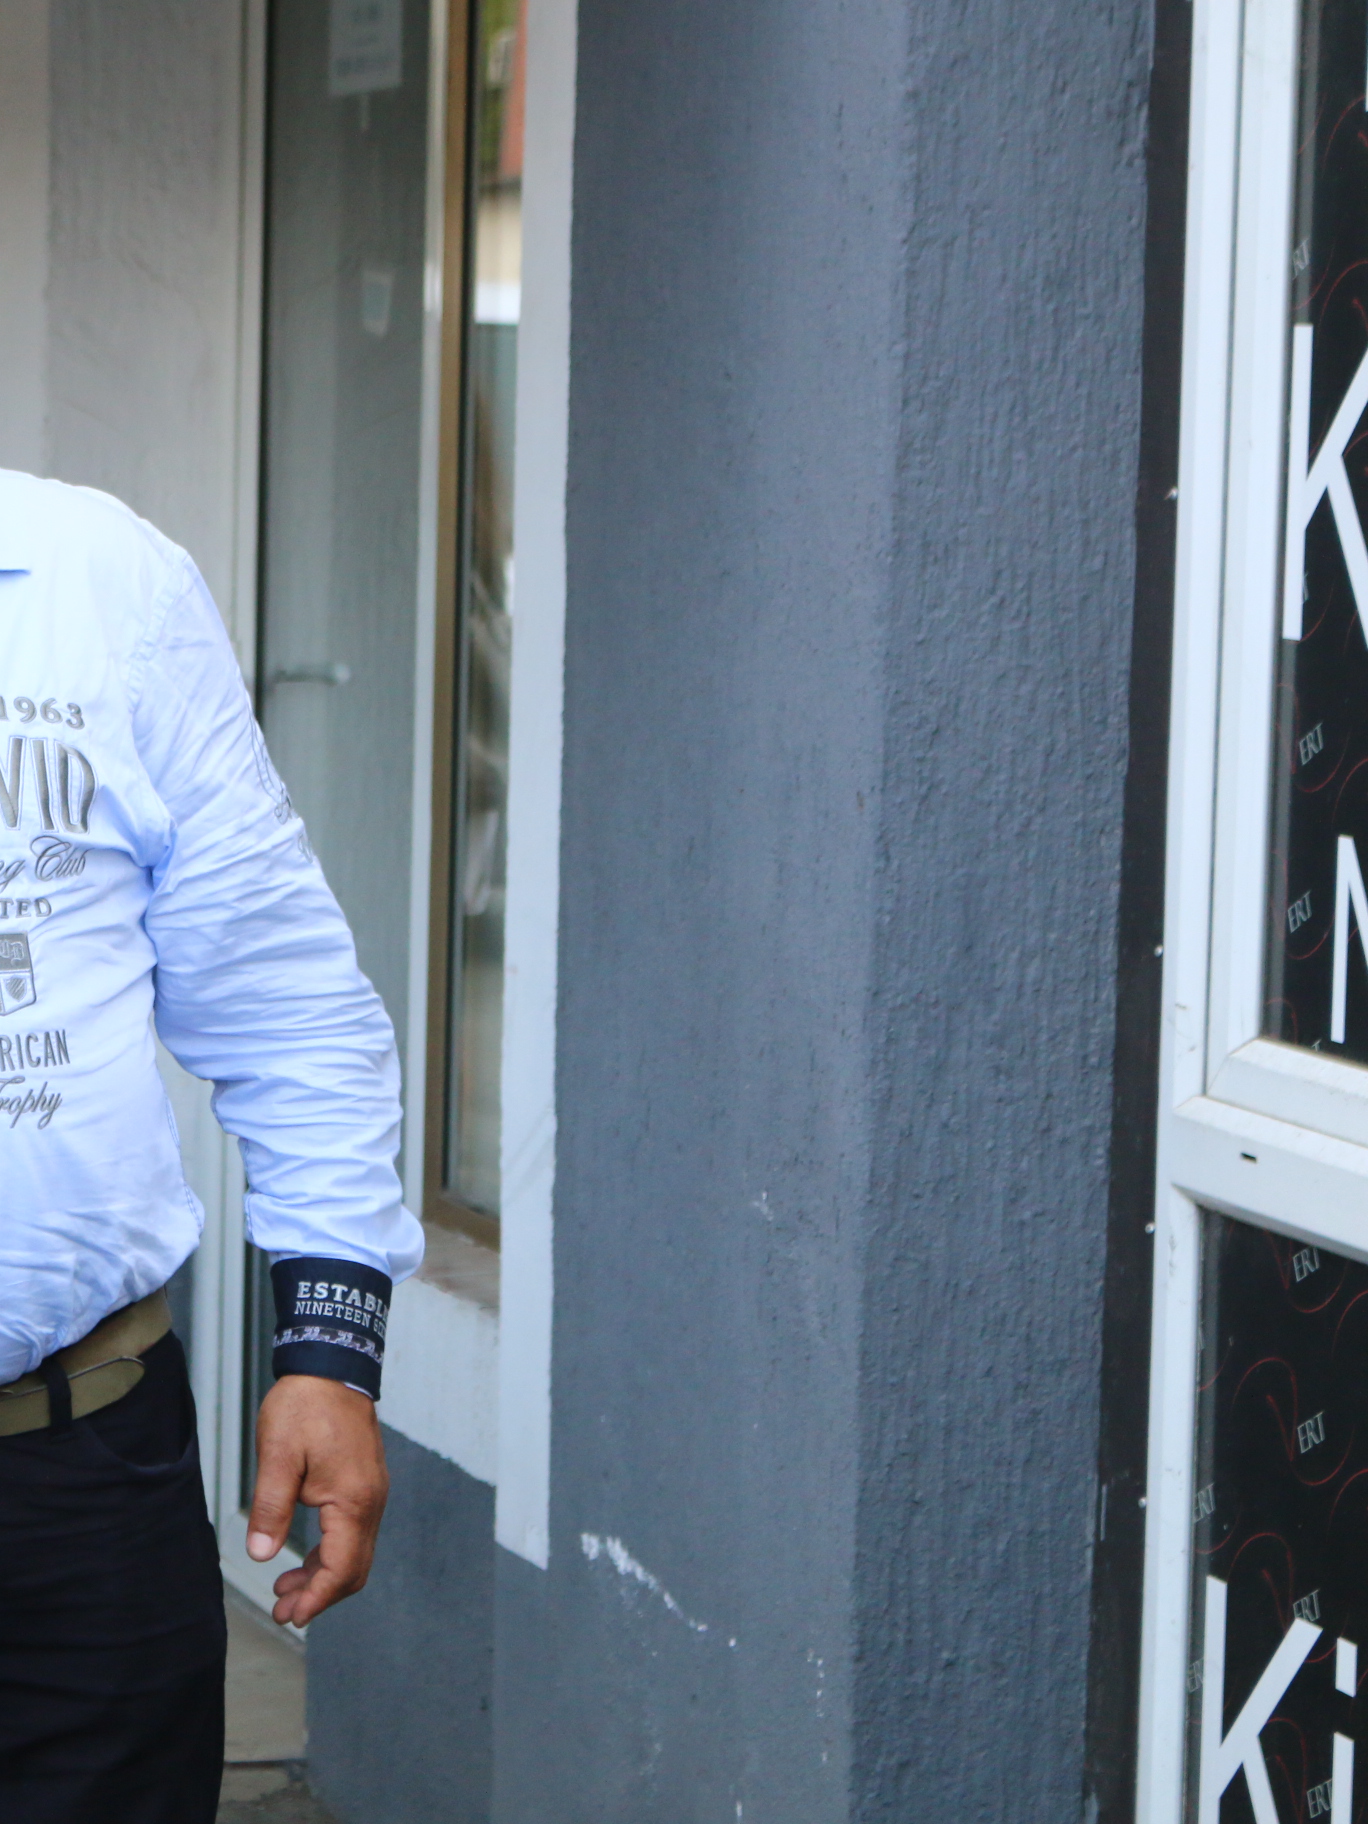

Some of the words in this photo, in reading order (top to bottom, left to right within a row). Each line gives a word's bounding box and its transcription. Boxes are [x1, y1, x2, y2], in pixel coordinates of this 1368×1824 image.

[30, 835, 94, 882] Club
[294, 1301, 371, 1328] NINETEEN
[1297, 1410, 1325, 1454] ERT
